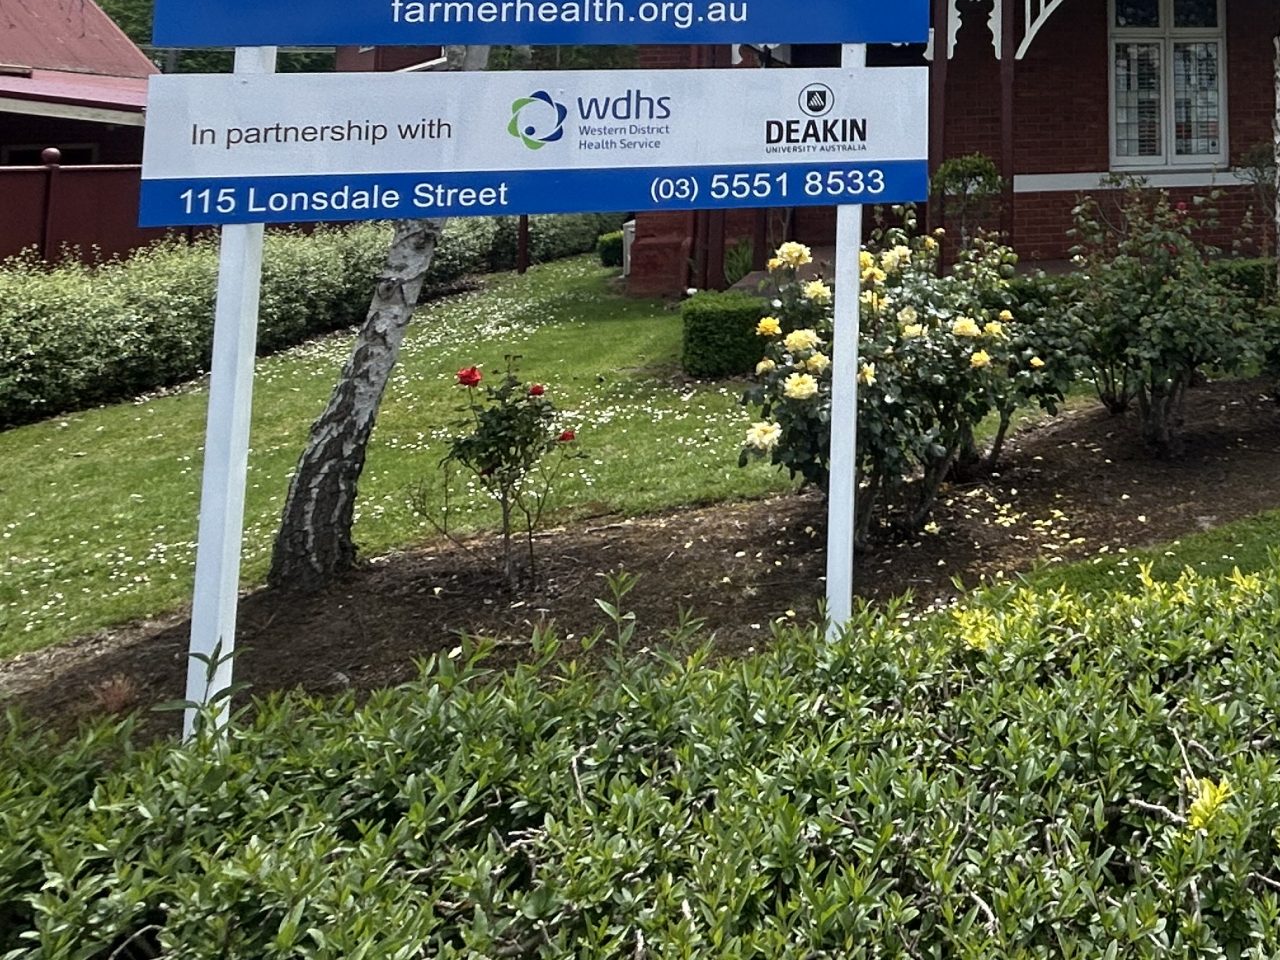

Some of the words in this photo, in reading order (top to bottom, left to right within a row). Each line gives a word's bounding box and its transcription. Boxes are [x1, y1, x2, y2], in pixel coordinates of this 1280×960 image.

[577, 89, 671, 120] wdhs
[191, 123, 216, 145] In
[226, 119, 388, 149] partnership
[397, 118, 452, 139] with
[579, 125, 627, 136] Western
[629, 124, 670, 135] District
[579, 139, 617, 150] Health
[619, 138, 661, 149] Service
[766, 118, 867, 144] DEAKIN
[766, 144, 817, 153] UNIVERSITY
[820, 143, 867, 152] AUSTRALIA
[179, 188, 236, 214] 115
[247, 185, 400, 212] Lonsdale
[412, 182, 508, 208] Street
[650, 176, 699, 203] (03)
[710, 172, 788, 199] 5551
[804, 169, 885, 196] 8533
